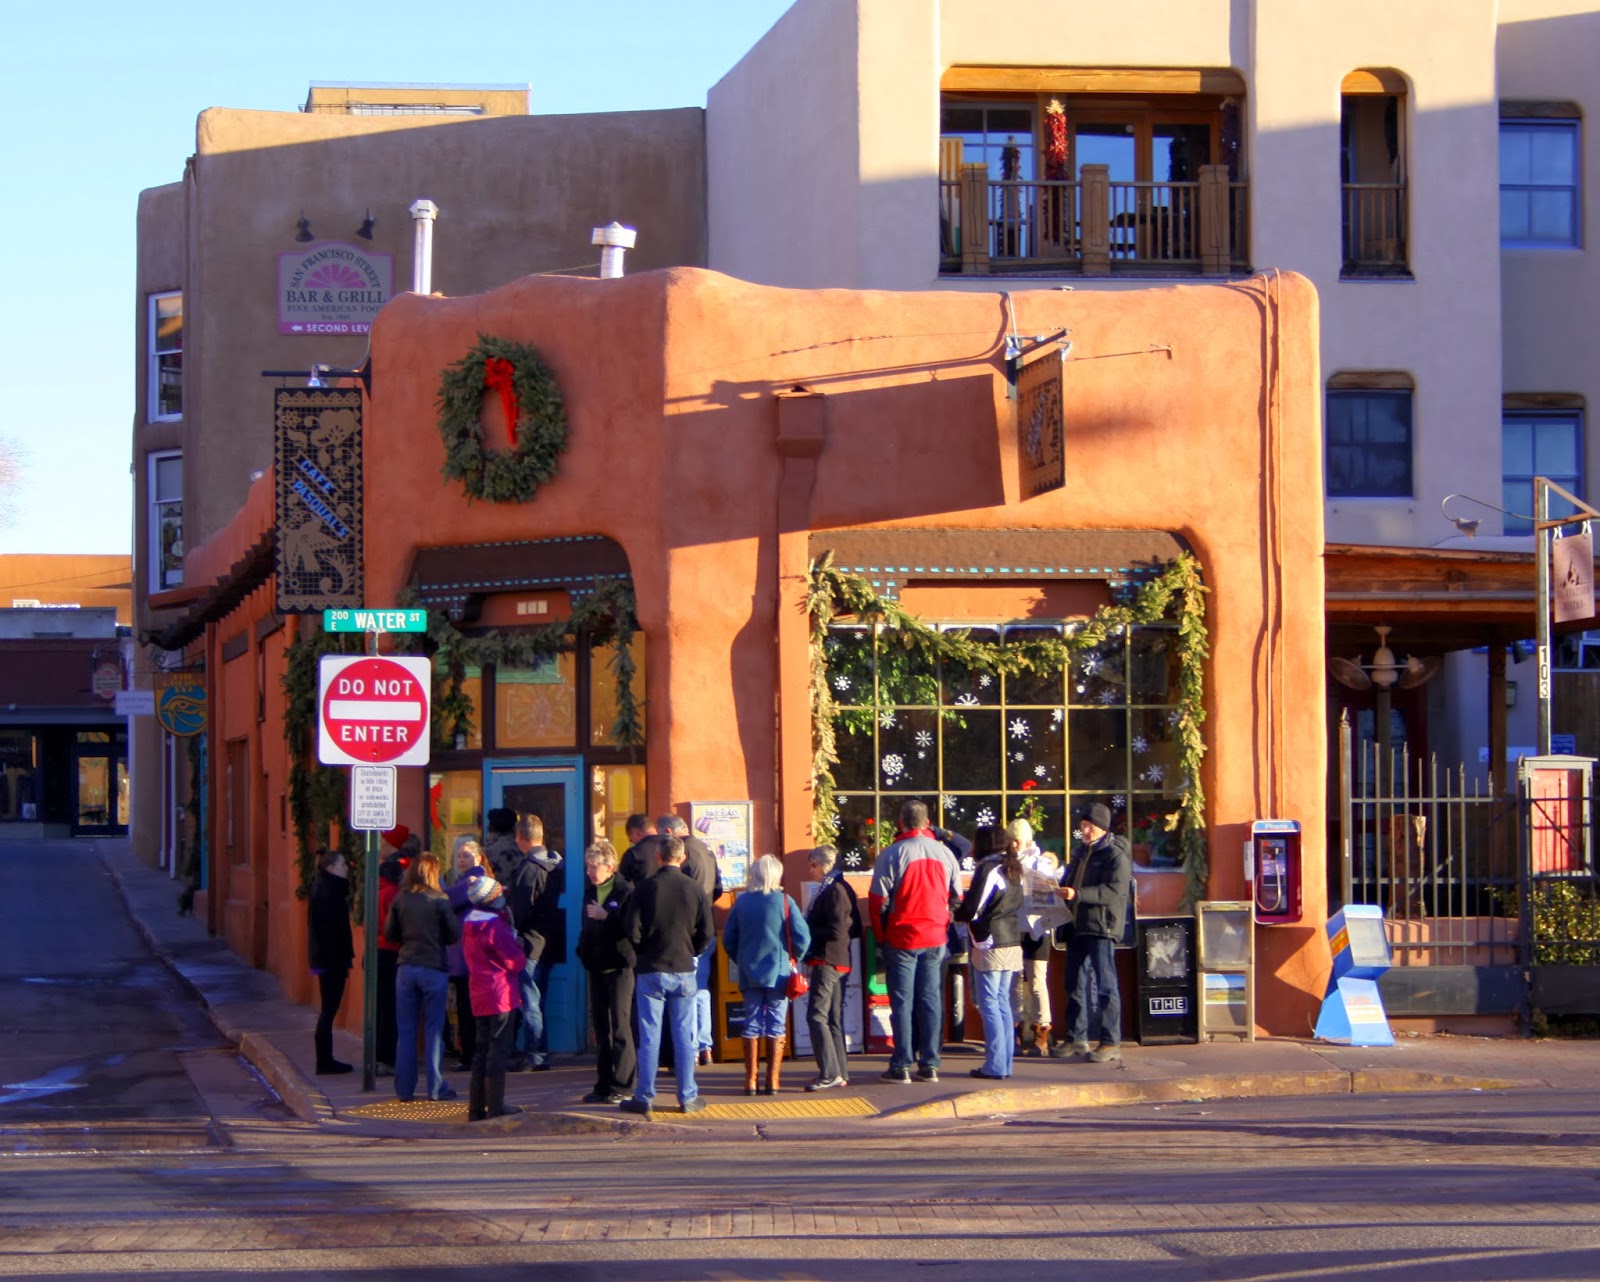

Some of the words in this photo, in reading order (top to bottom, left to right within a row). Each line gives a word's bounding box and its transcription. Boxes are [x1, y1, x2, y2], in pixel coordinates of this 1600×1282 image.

[290, 269, 304, 288] SAN
[301, 249, 354, 270] FRANCISCO
[354, 256, 381, 288] STREET
[286, 290, 318, 303] BAR
[322, 290, 333, 303] &
[338, 290, 386, 304] GRILL
[311, 305, 357, 313] AMERICAN
[306, 324, 348, 333] SECOND
[351, 324, 370, 333] LEV
[292, 479, 349, 538] PASQUAL'S
[331, 611, 349, 620] 200
[354, 612, 407, 629] WATER
[409, 613, 421, 622] ST
[331, 622, 337, 631] E
[338, 678, 365, 695] DO
[374, 679, 413, 697] NOT
[341, 725, 408, 743] ENTER
[1152, 999, 1185, 1010] THE
